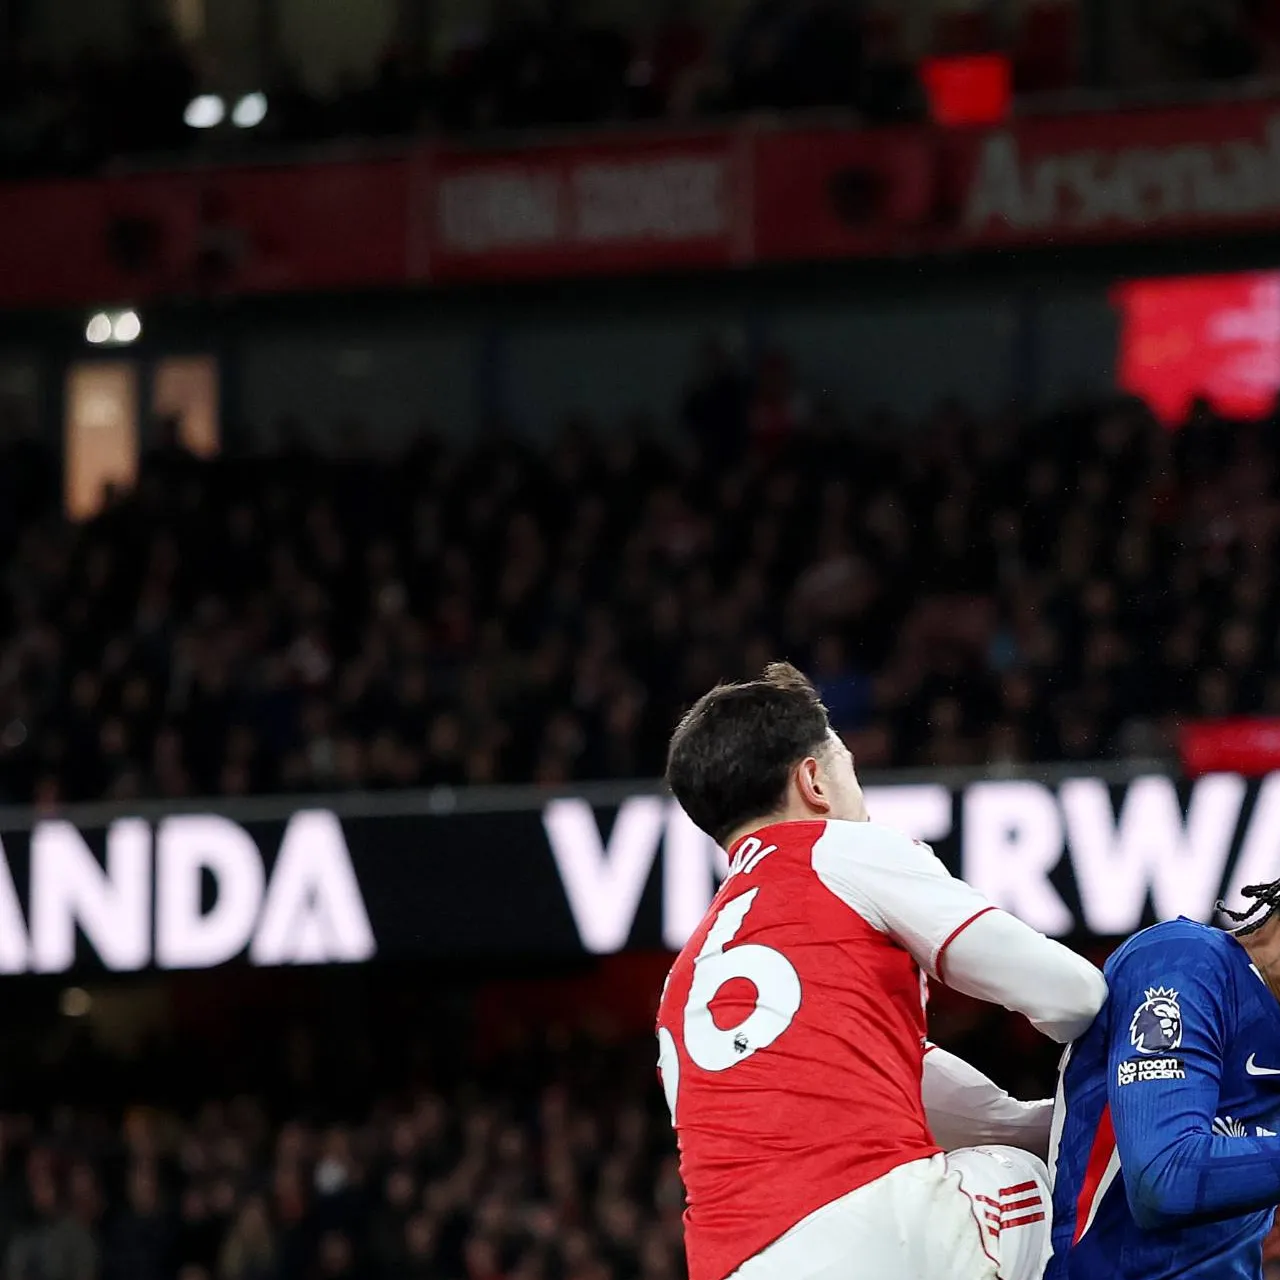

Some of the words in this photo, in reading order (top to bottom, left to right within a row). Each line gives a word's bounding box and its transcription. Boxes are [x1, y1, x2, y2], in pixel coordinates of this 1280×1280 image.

[1117, 1060, 1137, 1075] No
[1138, 1058, 1178, 1071] room
[1138, 1068, 1186, 1081] racism
